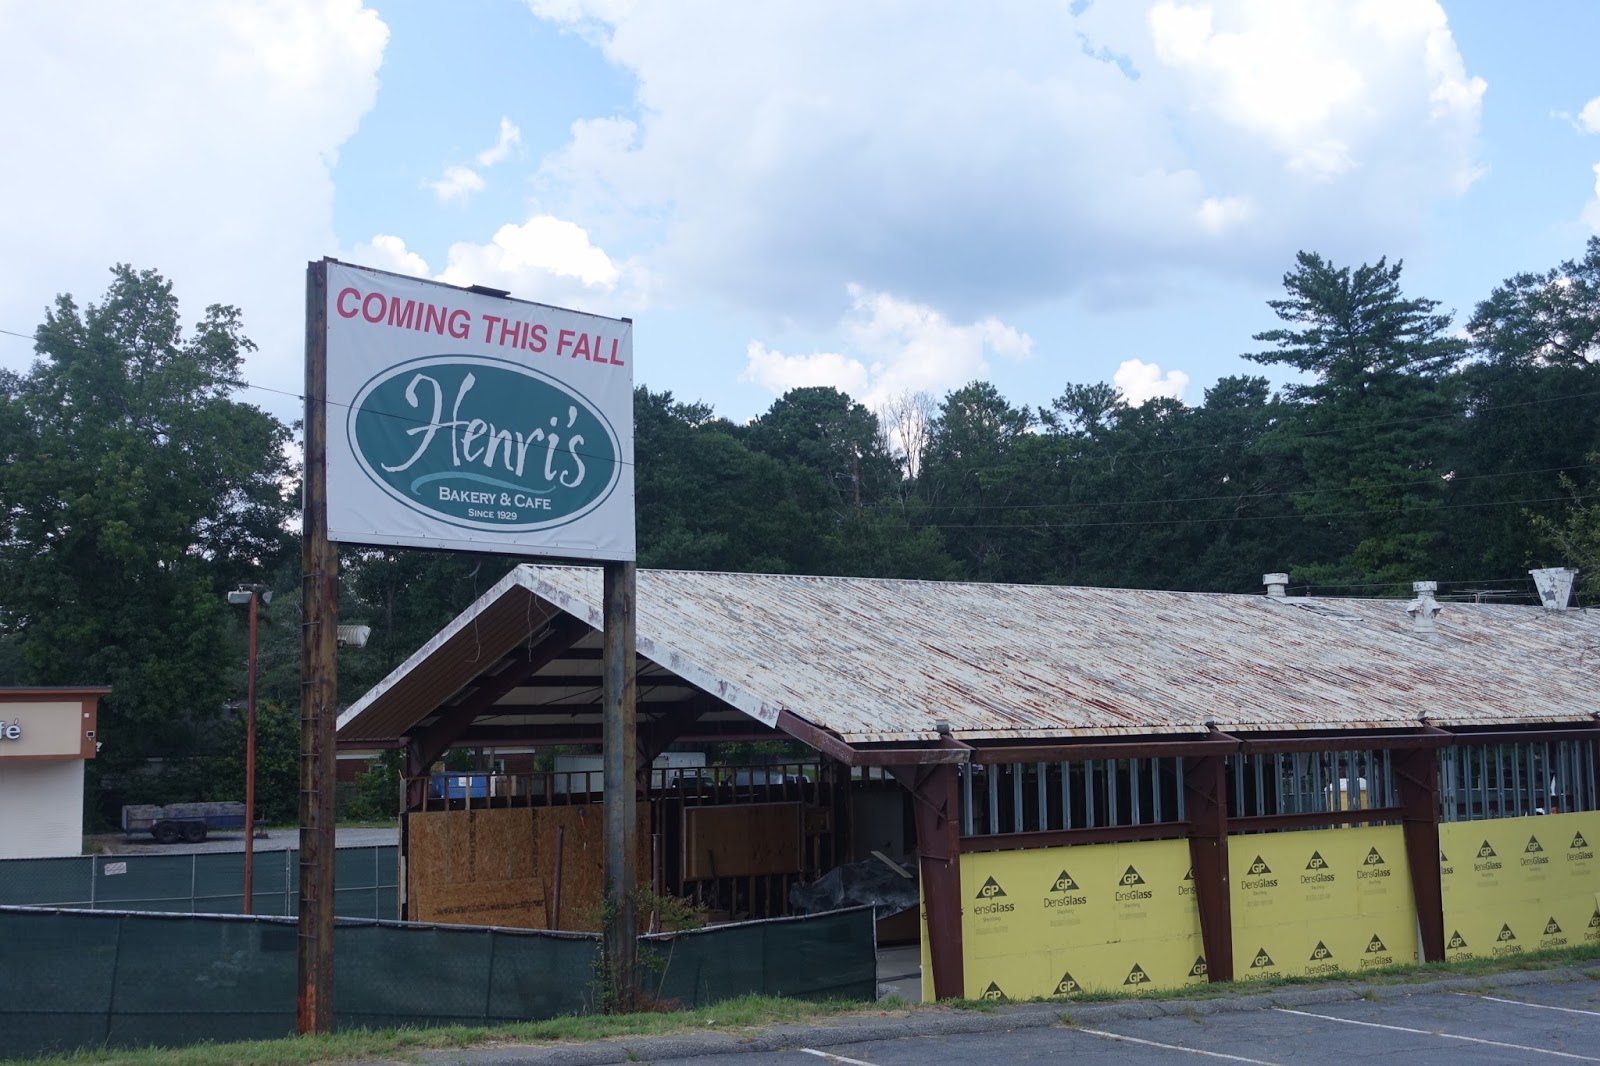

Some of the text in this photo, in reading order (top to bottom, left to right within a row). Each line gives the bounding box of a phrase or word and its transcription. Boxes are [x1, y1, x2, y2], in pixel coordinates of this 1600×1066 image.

[336, 287, 625, 366] COMING THIS FALL
[380, 372, 586, 488] Henri's
[439, 486, 552, 510] BAKERY & CAFE
[497, 510, 518, 521] 1929
[1480, 847, 1492, 857] GP
[1310, 858, 1323, 868] GP
[1367, 854, 1380, 864] GP
[1520, 856, 1549, 867] DensGlass
[1251, 863, 1266, 874] GP
[1056, 878, 1073, 890] GP
[1123, 873, 1139, 885] GP
[1241, 878, 1278, 890] DensGlass
[1300, 873, 1335, 884] DensGlass
[981, 885, 1000, 897] GP
[1043, 895, 1087, 908] DensGlass
[1500, 930, 1512, 940] GP
[1369, 941, 1382, 951] GP
[1450, 937, 1462, 947] GP
[1313, 948, 1327, 958] GP
[1254, 955, 1268, 967] GP
[1360, 955, 1393, 968] DensGlass
[1304, 963, 1339, 975] DensGlass
[1129, 971, 1144, 983] GP
[1059, 980, 1075, 992] GP
